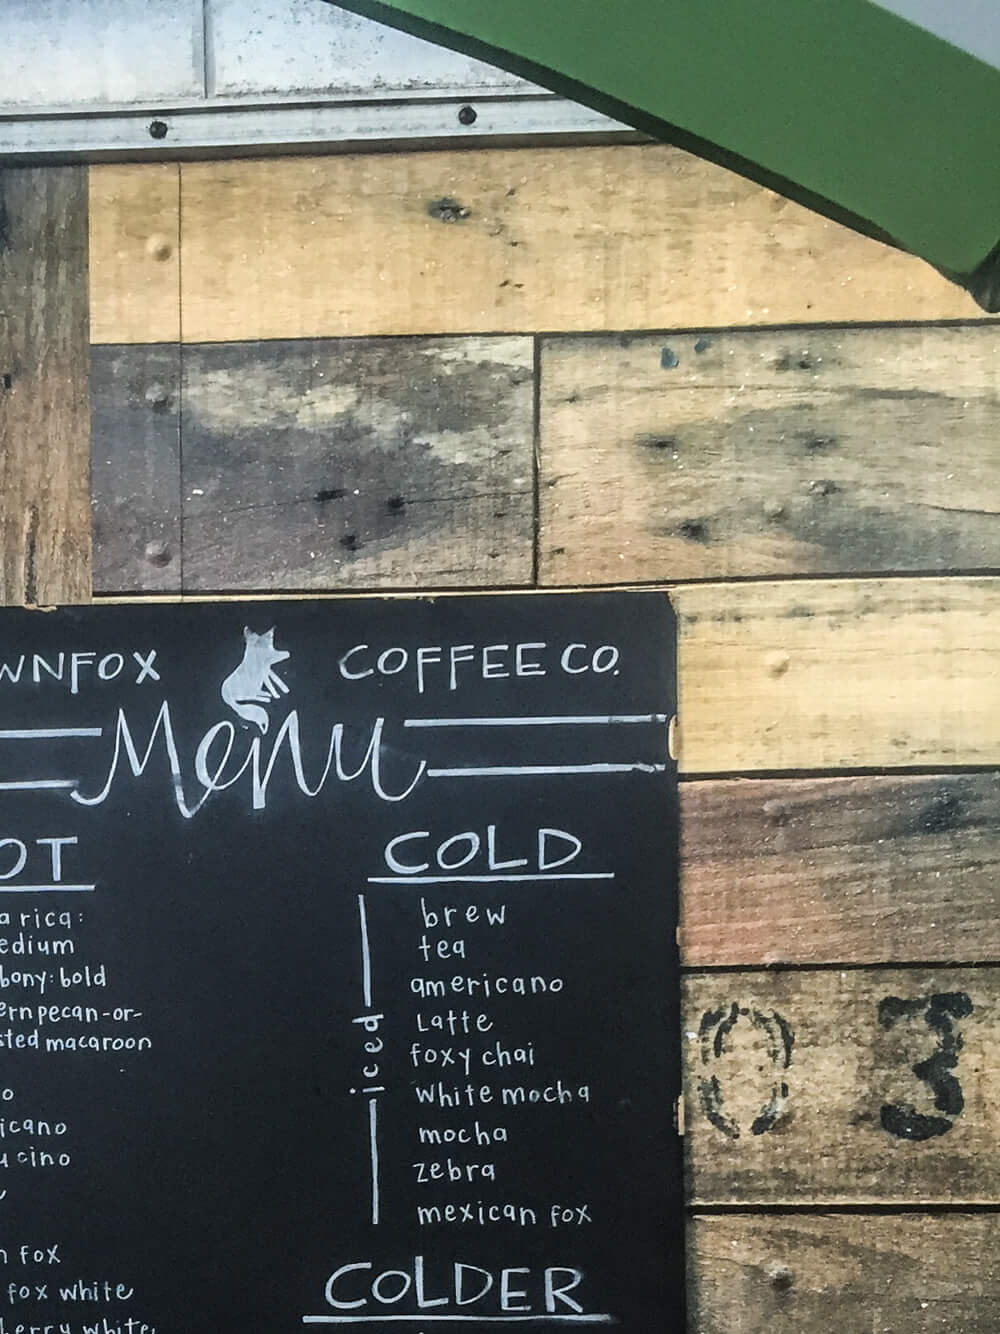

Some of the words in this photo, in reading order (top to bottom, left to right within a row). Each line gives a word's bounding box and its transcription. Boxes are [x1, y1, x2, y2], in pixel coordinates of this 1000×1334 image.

[339, 643, 547, 693] COFFEE
[560, 644, 620, 676] CO.
[71, 700, 426, 819] Menu
[385, 825, 582, 874] COLD
[420, 897, 506, 928] brew
[418, 935, 466, 962] tea
[59, 965, 107, 987] bold
[410, 973, 564, 998] americano
[46, 1035, 152, 1052] macaroon
[349, 1014, 385, 1094] iced
[410, 1043, 472, 1075] foxy
[482, 1041, 535, 1067] chai
[416, 1082, 493, 1107] white
[501, 1081, 590, 1106] mocha
[419, 1121, 508, 1145] mocha
[417, 1201, 536, 1226] mexican
[550, 1204, 592, 1227] fox
[19, 1244, 61, 1265] fox
[8, 1284, 48, 1303] fox
[59, 1280, 134, 1301] white
[325, 1255, 584, 1313] COLDER
